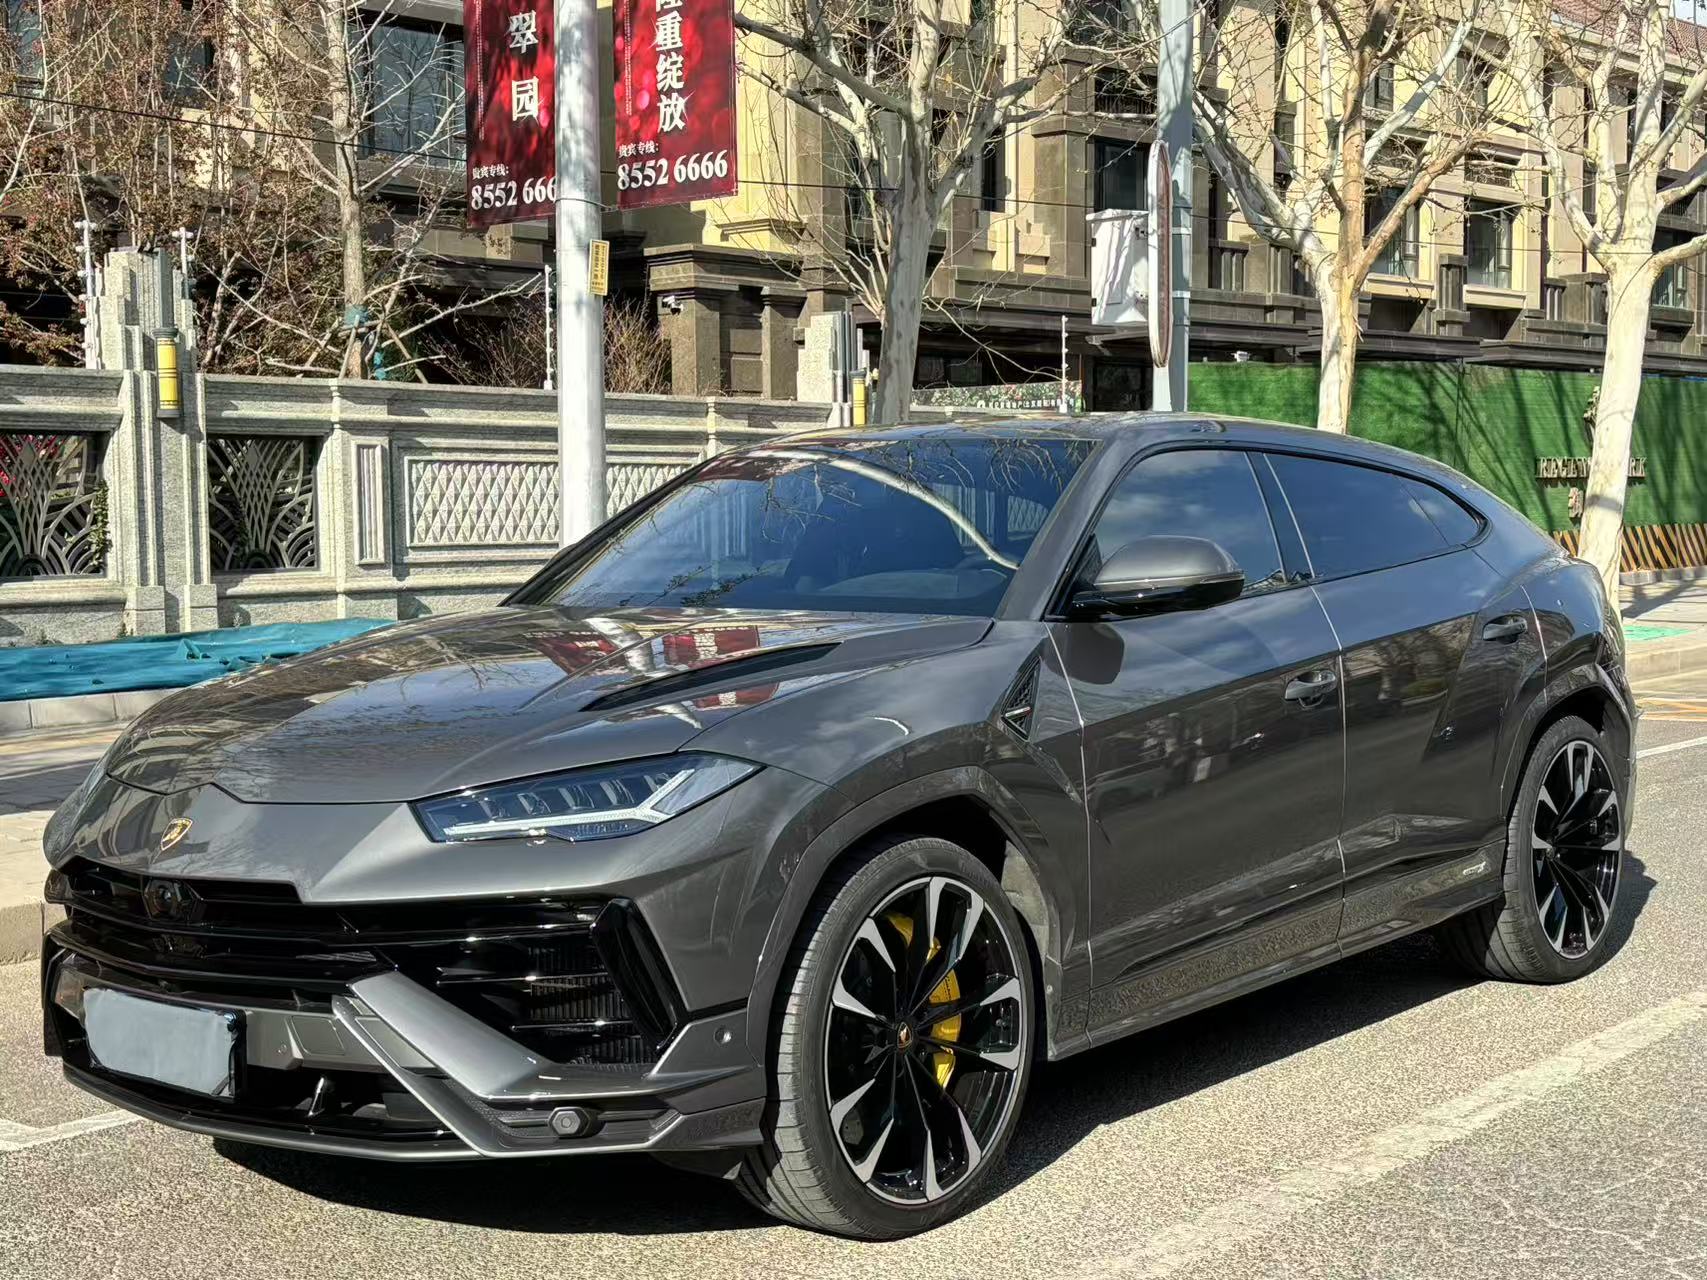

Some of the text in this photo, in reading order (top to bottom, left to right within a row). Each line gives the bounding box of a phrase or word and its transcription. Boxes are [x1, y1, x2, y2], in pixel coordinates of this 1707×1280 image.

[508, 9, 539, 121] 翠园
[656, 0, 685, 133] 重绽放
[471, 175, 557, 211] 8552 666
[617, 149, 728, 190] 8552 6666
